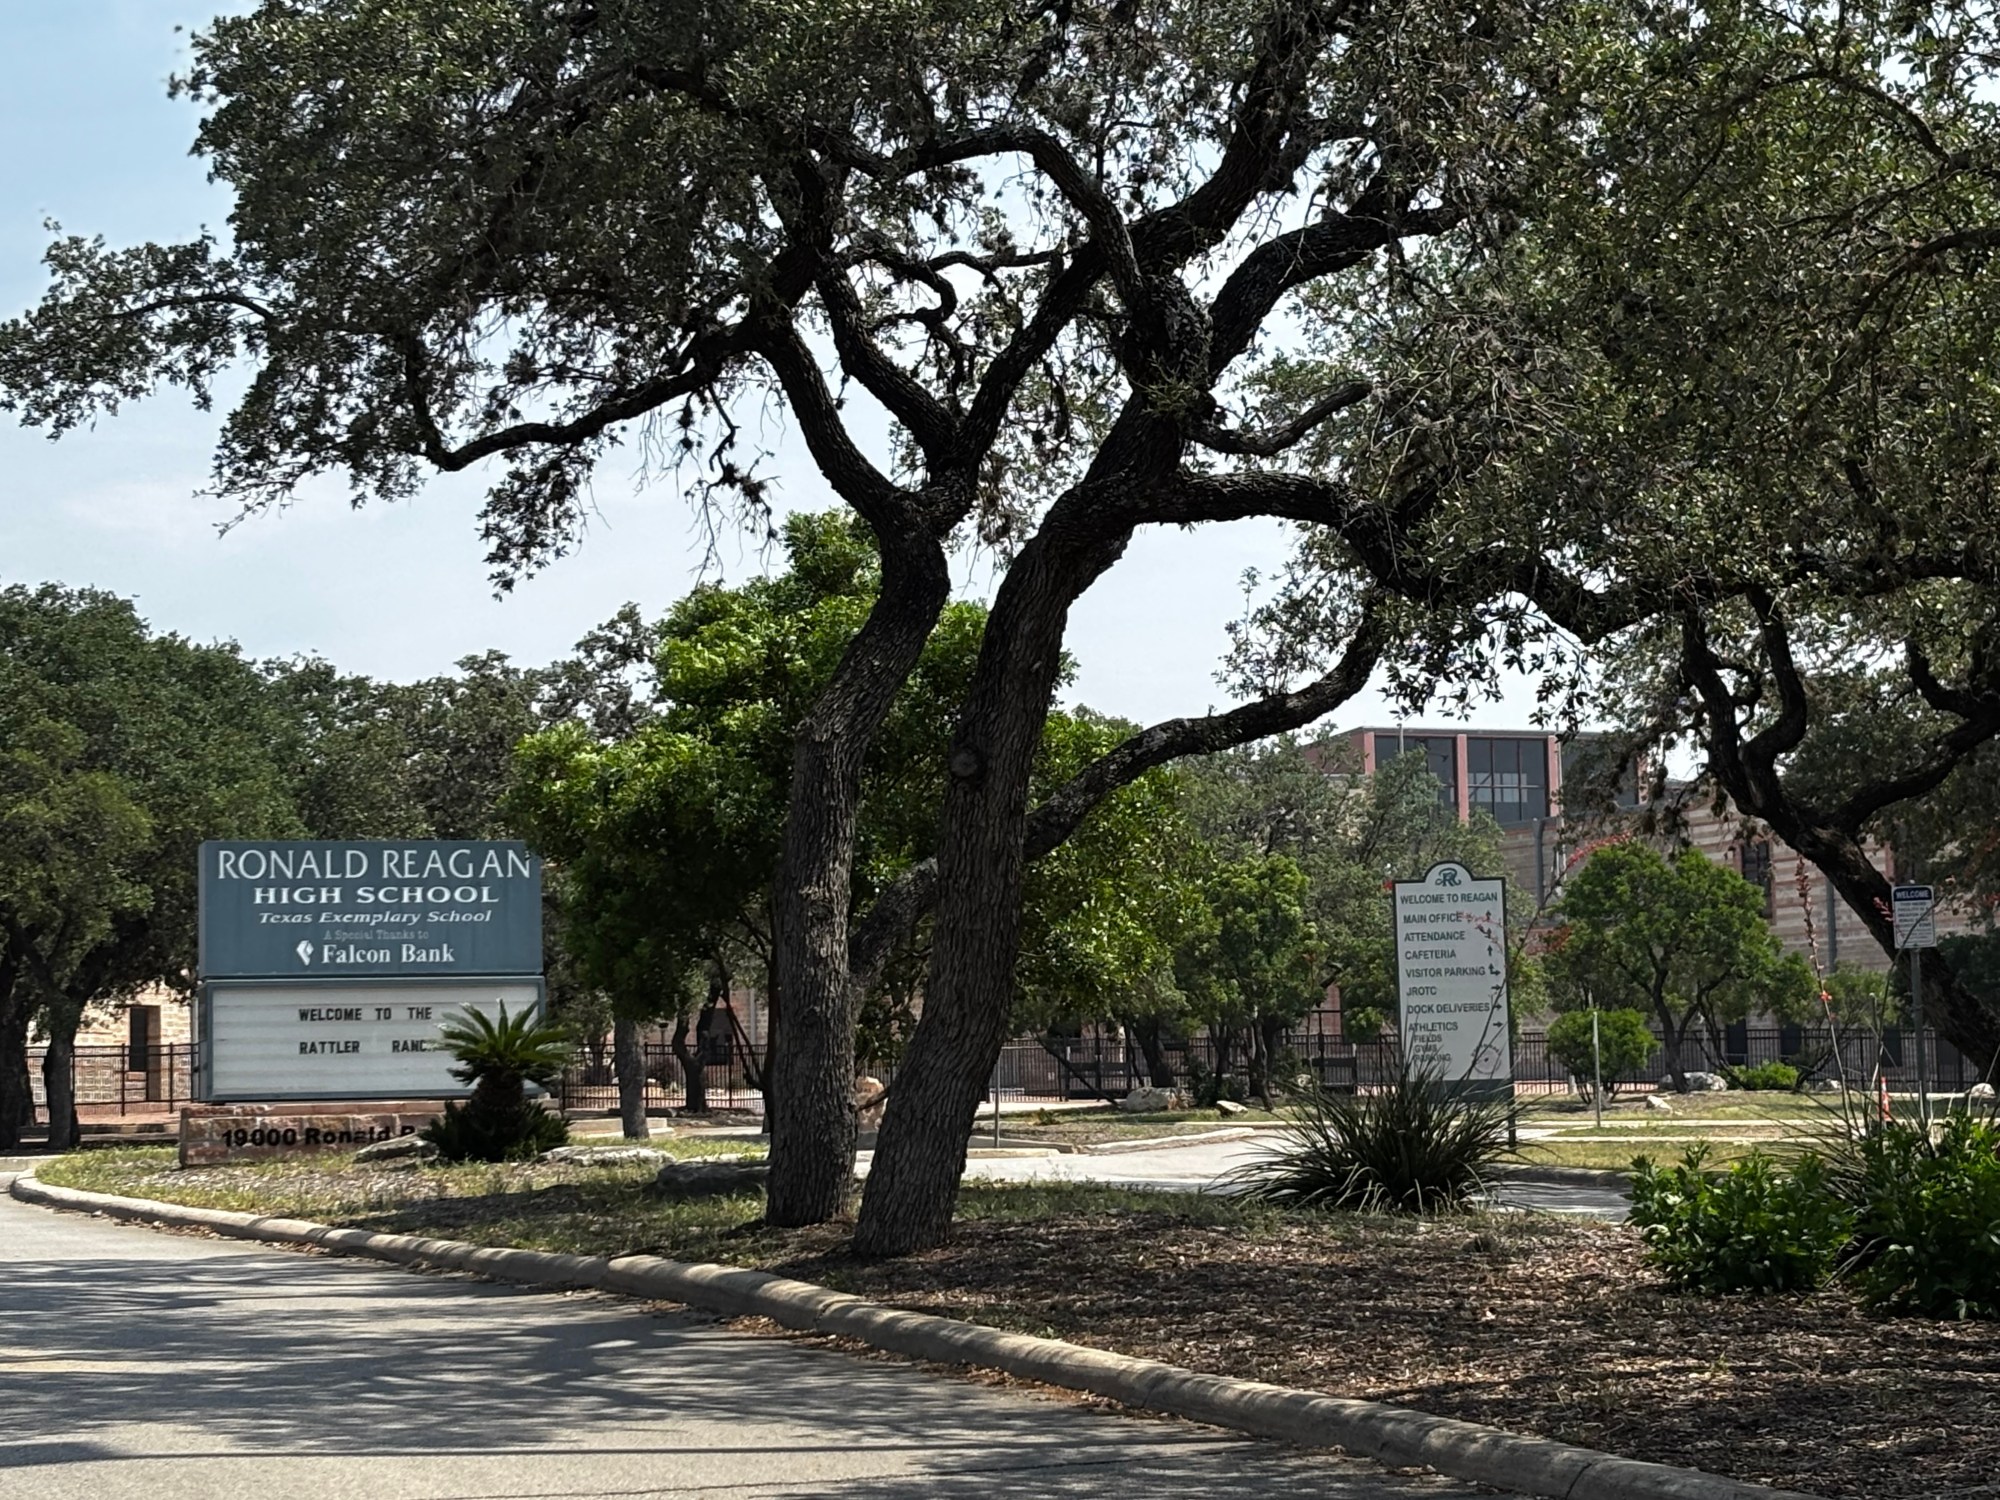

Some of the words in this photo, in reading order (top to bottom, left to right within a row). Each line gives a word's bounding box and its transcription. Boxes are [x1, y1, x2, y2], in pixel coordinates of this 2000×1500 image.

[218, 850, 369, 880] RONALD
[382, 849, 531, 879] REAGAN
[253, 887, 343, 904] HIGH
[356, 886, 500, 904] SCHOOL
[1400, 894, 1445, 905] WELCOME
[1446, 893, 1459, 903] TO
[1461, 892, 1498, 902] REAGAN
[1895, 890, 1929, 899] WELCOME
[259, 912, 313, 924] Texas
[318, 910, 421, 926] Exemplary
[426, 909, 492, 923] School
[1403, 914, 1427, 924] MAIN
[1428, 912, 1463, 923] OFFICE
[323, 930, 332, 940] A
[334, 929, 373, 942] Special
[376, 929, 415, 940] Thanks
[417, 930, 429, 940] to
[1404, 931, 1466, 942] ATTENDANCE
[321, 944, 391, 964] Falcon
[401, 943, 455, 963] Bank
[1404, 949, 1456, 960] CAFETERIA
[1405, 968, 1442, 978] VISITOR
[1444, 966, 1486, 977] PARKING
[1406, 986, 1437, 996] JROTC
[299, 1008, 362, 1021] WELCOME
[375, 1008, 392, 1020] TO
[407, 1007, 432, 1020] THE
[1407, 1004, 1435, 1014] DOCK
[1436, 1002, 1490, 1013] DELIVERIES
[1408, 1022, 1458, 1032] ATHLETICS
[1414, 1034, 1442, 1042] FIELDS
[299, 1041, 360, 1054] RATTLER
[392, 1040, 436, 1053] RANC
[222, 1128, 297, 1147] 19000
[304, 1126, 390, 1145] Ronald
